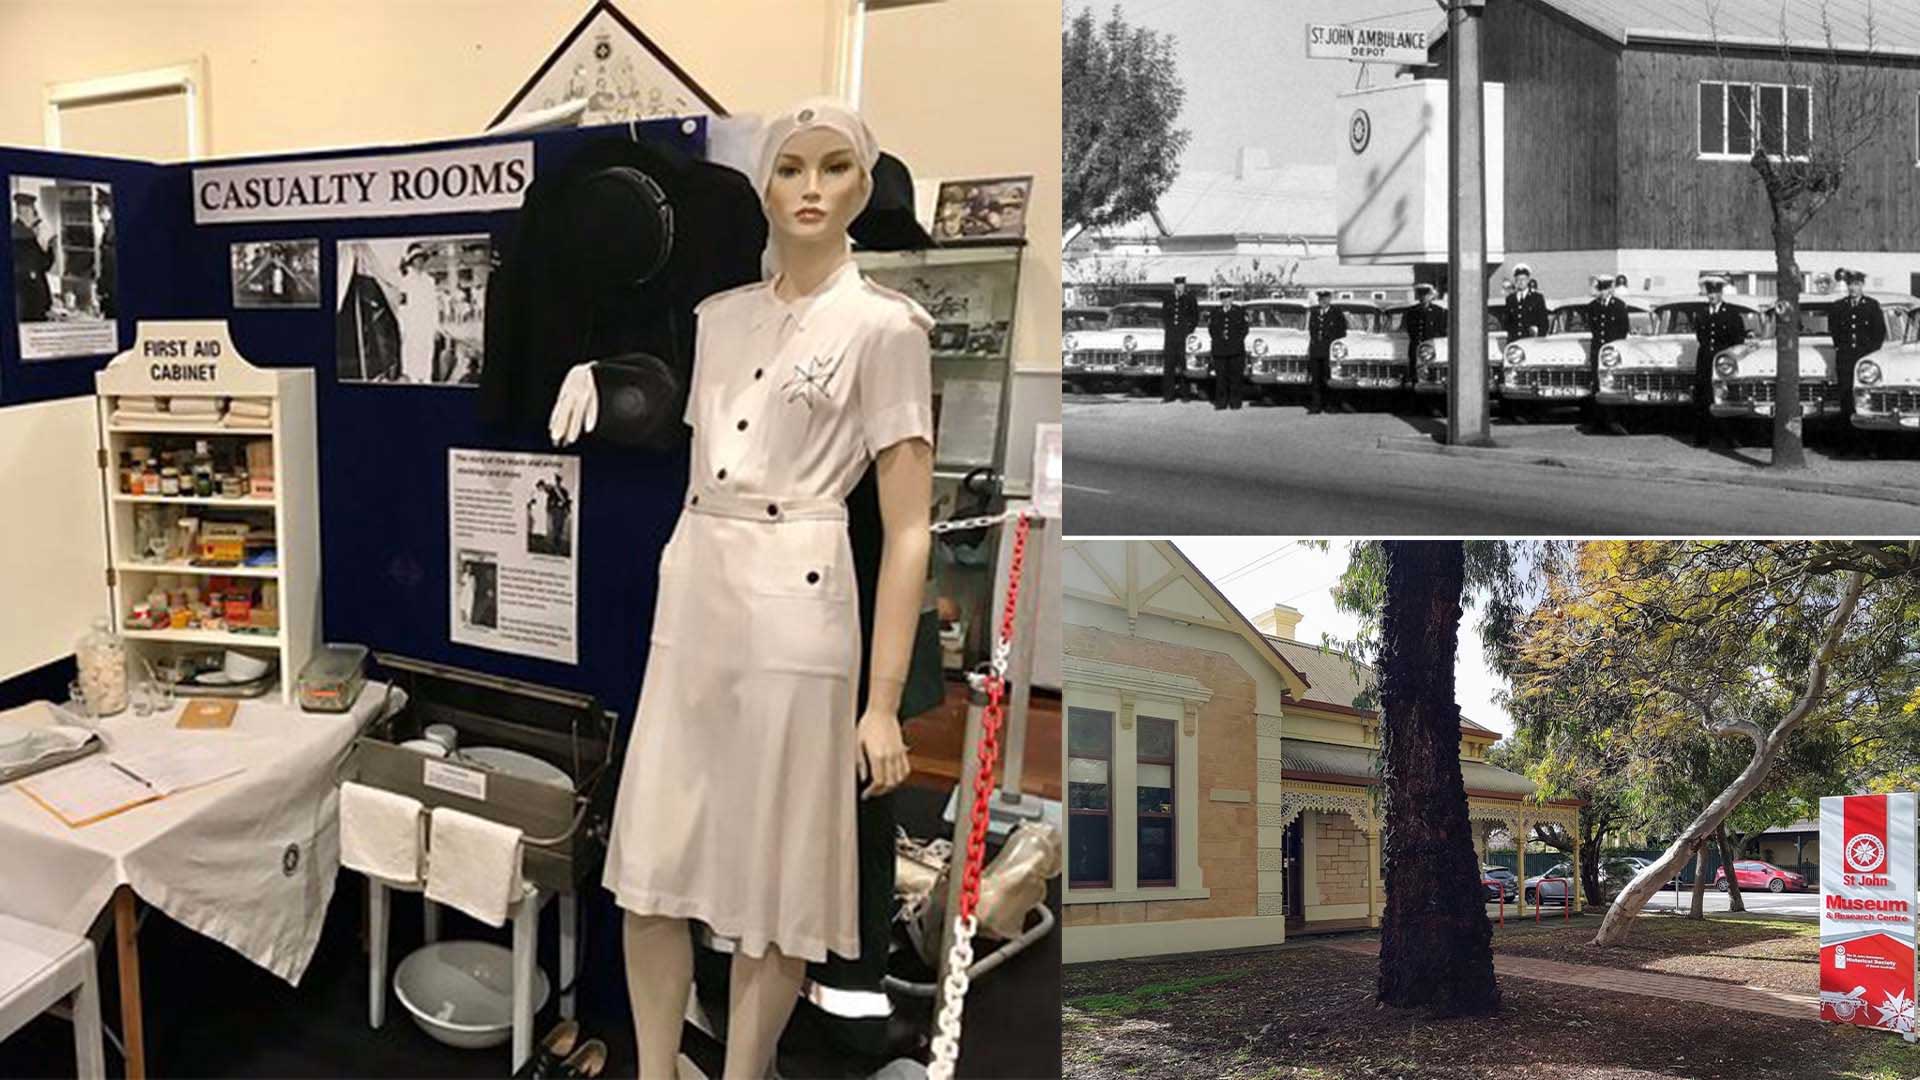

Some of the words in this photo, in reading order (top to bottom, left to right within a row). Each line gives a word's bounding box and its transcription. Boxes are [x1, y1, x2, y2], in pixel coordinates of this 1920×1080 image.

[1325, 29, 1354, 46] JOHN
[1357, 29, 1425, 49] AMBULANCE
[1350, 47, 1386, 57] DEPOT
[200, 171, 377, 211] CASUALTY
[390, 159, 526, 201] ROOMS
[143, 340, 187, 358] FIRST
[193, 340, 221, 357] AID
[150, 364, 217, 381] CABINET
[1843, 875, 1855, 886] St
[1858, 874, 1888, 887] John
[1826, 895, 1907, 912] Museum
[1834, 912, 1875, 921] Research
[1876, 914, 1908, 922] Centre
